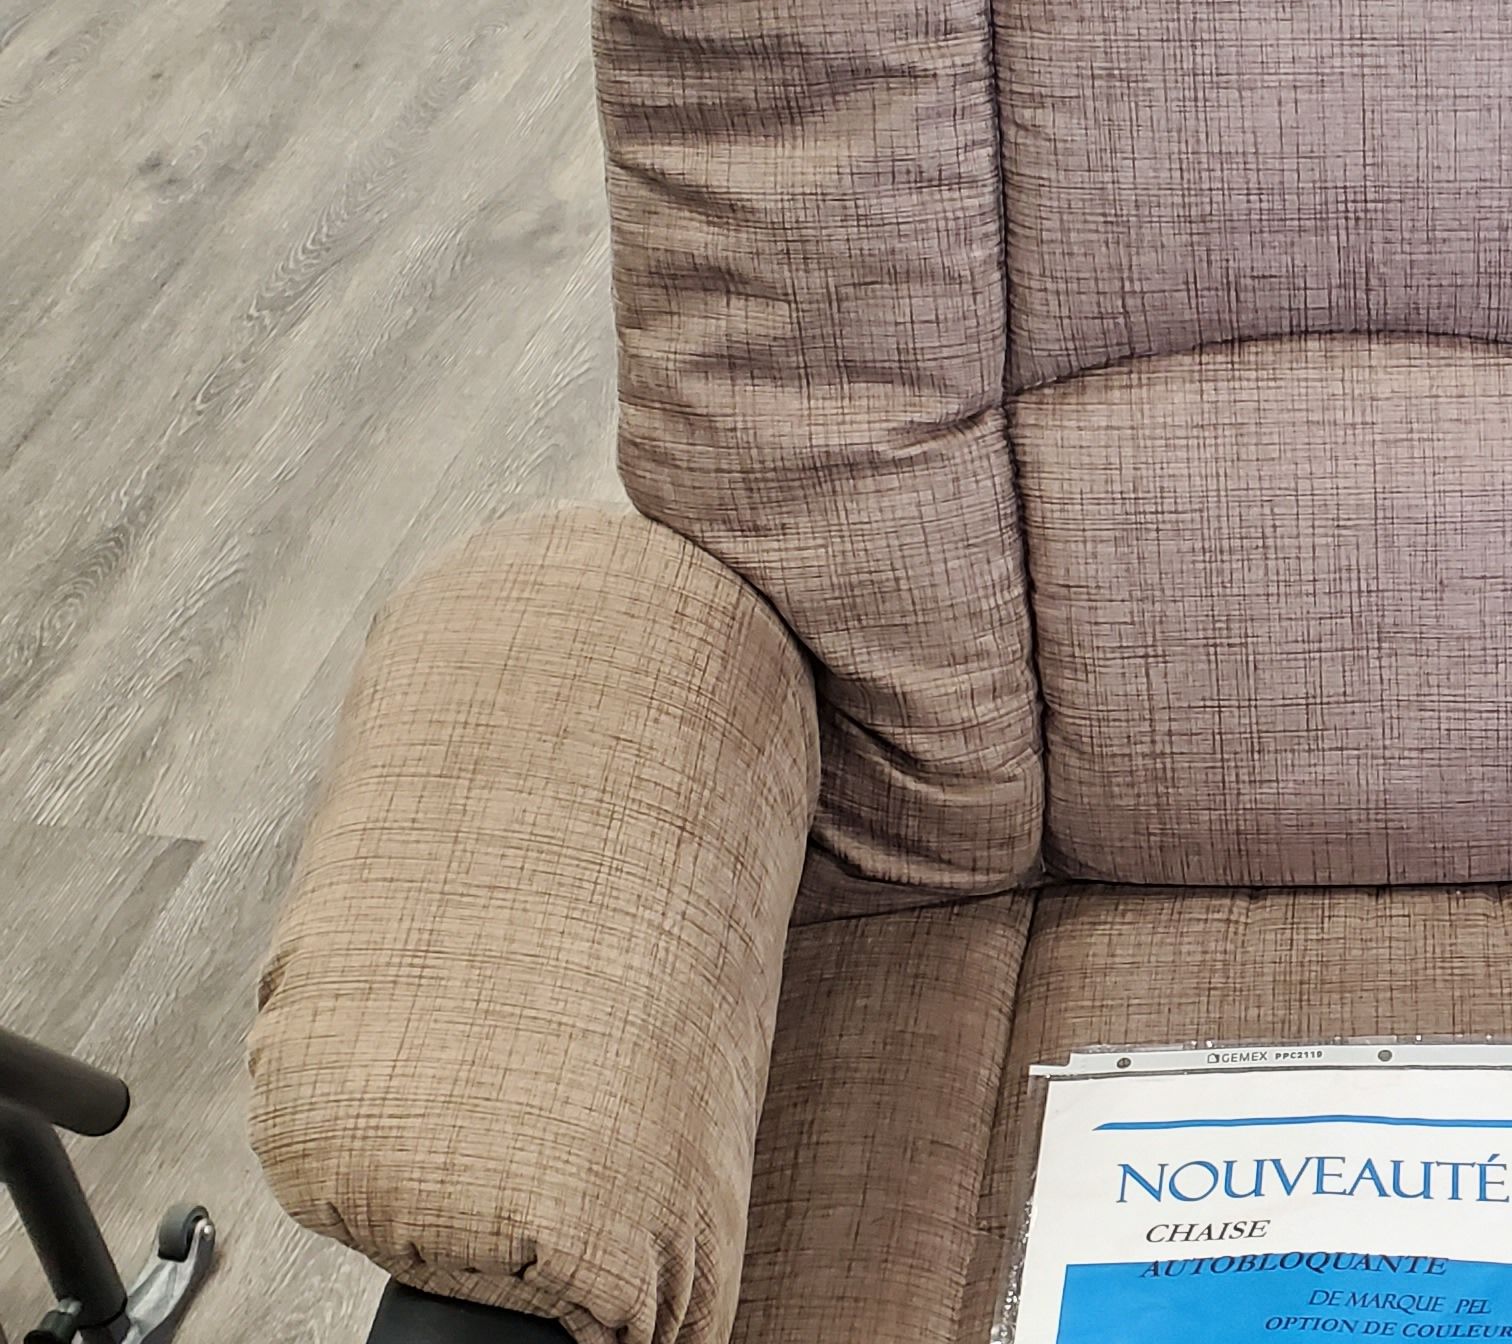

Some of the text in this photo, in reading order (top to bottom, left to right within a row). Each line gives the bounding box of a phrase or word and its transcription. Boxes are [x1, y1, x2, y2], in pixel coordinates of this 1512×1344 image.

[1221, 1051, 1268, 1063] GEMEX
[1115, 1153, 1510, 1203] NOUVEAUTÉ
[1145, 1219, 1271, 1243] CHAISE
[1139, 1252, 1450, 1277] AUTOBLOQUANTE
[1308, 1289, 1345, 1306] DE
[1345, 1291, 1446, 1314] MARQUE
[1265, 1316, 1361, 1333] OPTION
[1362, 1321, 1398, 1336] DE
